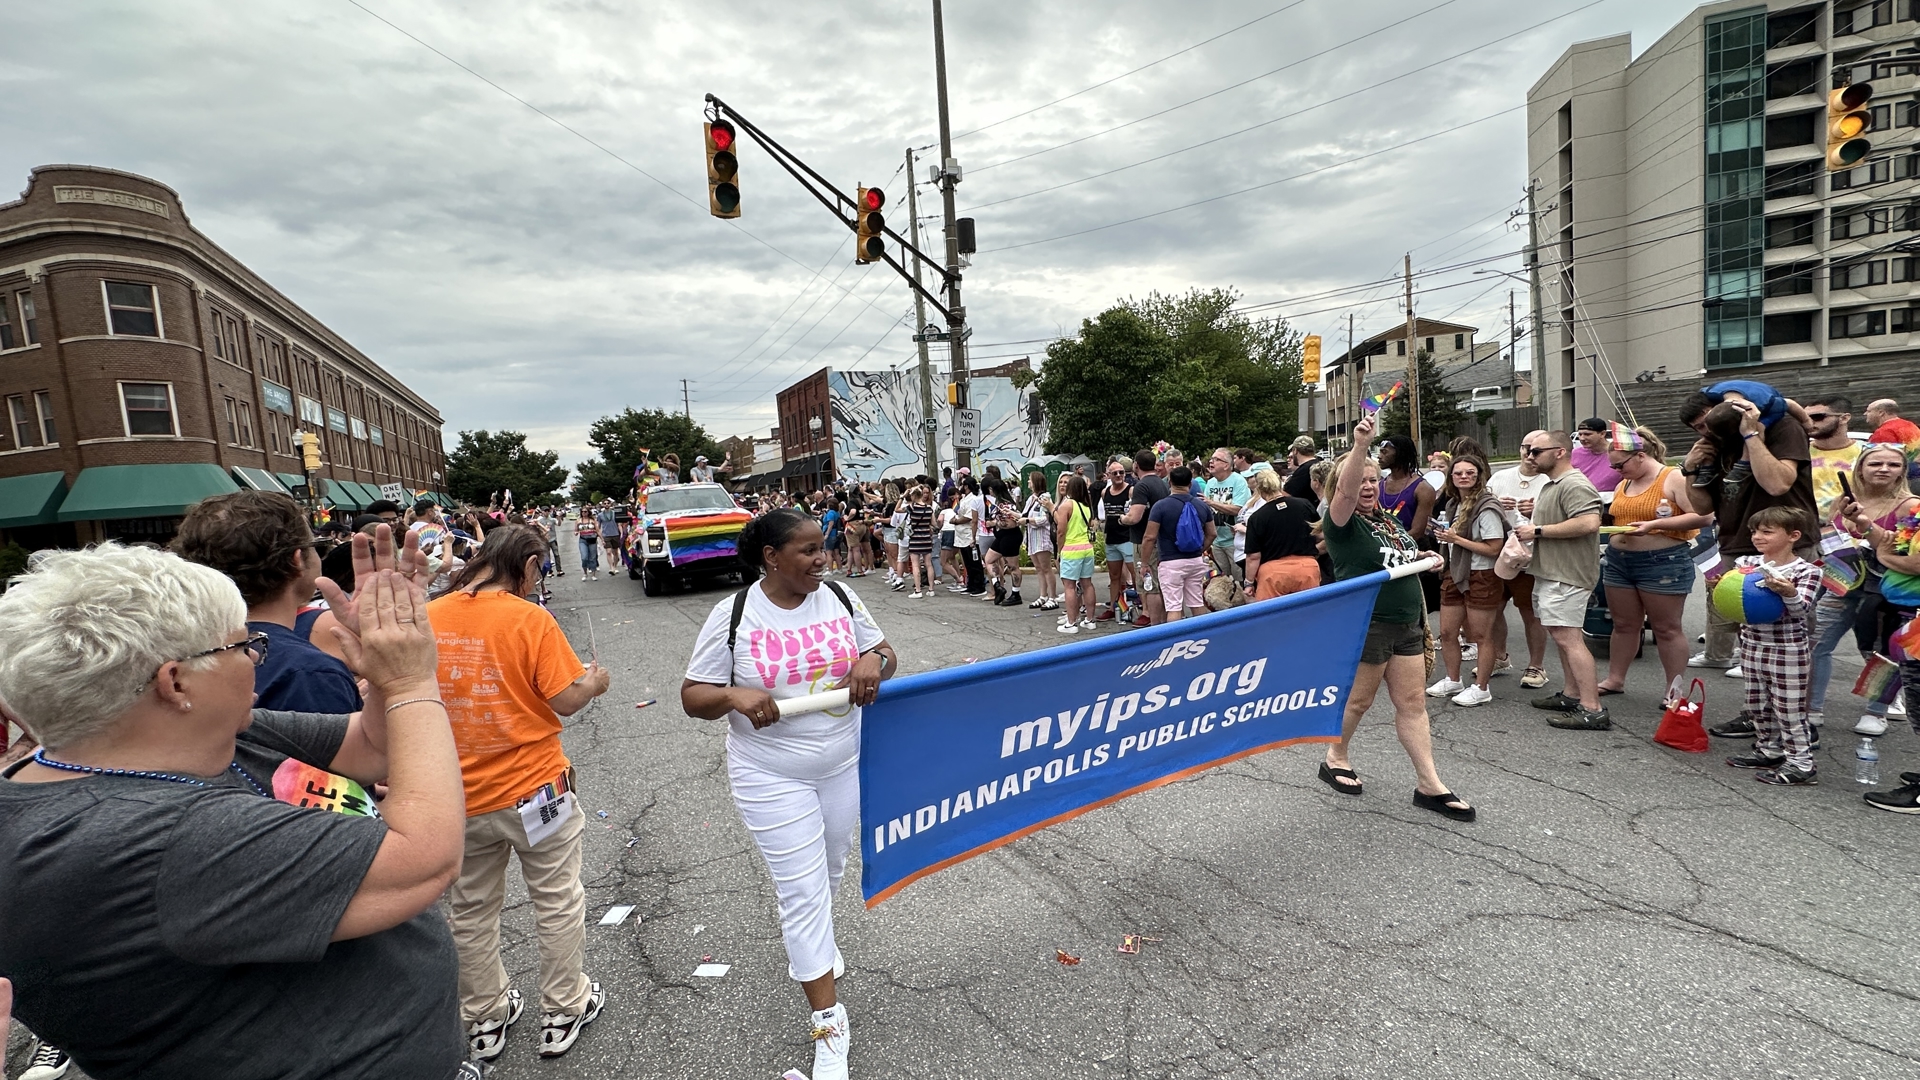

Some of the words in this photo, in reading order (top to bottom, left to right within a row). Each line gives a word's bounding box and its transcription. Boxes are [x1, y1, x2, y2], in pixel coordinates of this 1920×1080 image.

[62, 189, 95, 200] THE
[102, 193, 164, 213] ARGYLE
[960, 412, 974, 420] NO
[959, 421, 975, 429] TURN
[961, 429, 972, 437] ON
[960, 438, 973, 446] RED
[383, 485, 400, 493] ONE
[384, 491, 401, 500] WAY
[471, 636, 485, 646] list
[1000, 657, 1268, 759] myips.org
[874, 743, 1111, 854] INDIANAPOLIS
[1117, 711, 1217, 759] PUBLIC
[1221, 684, 1340, 728] SCHOOLS
